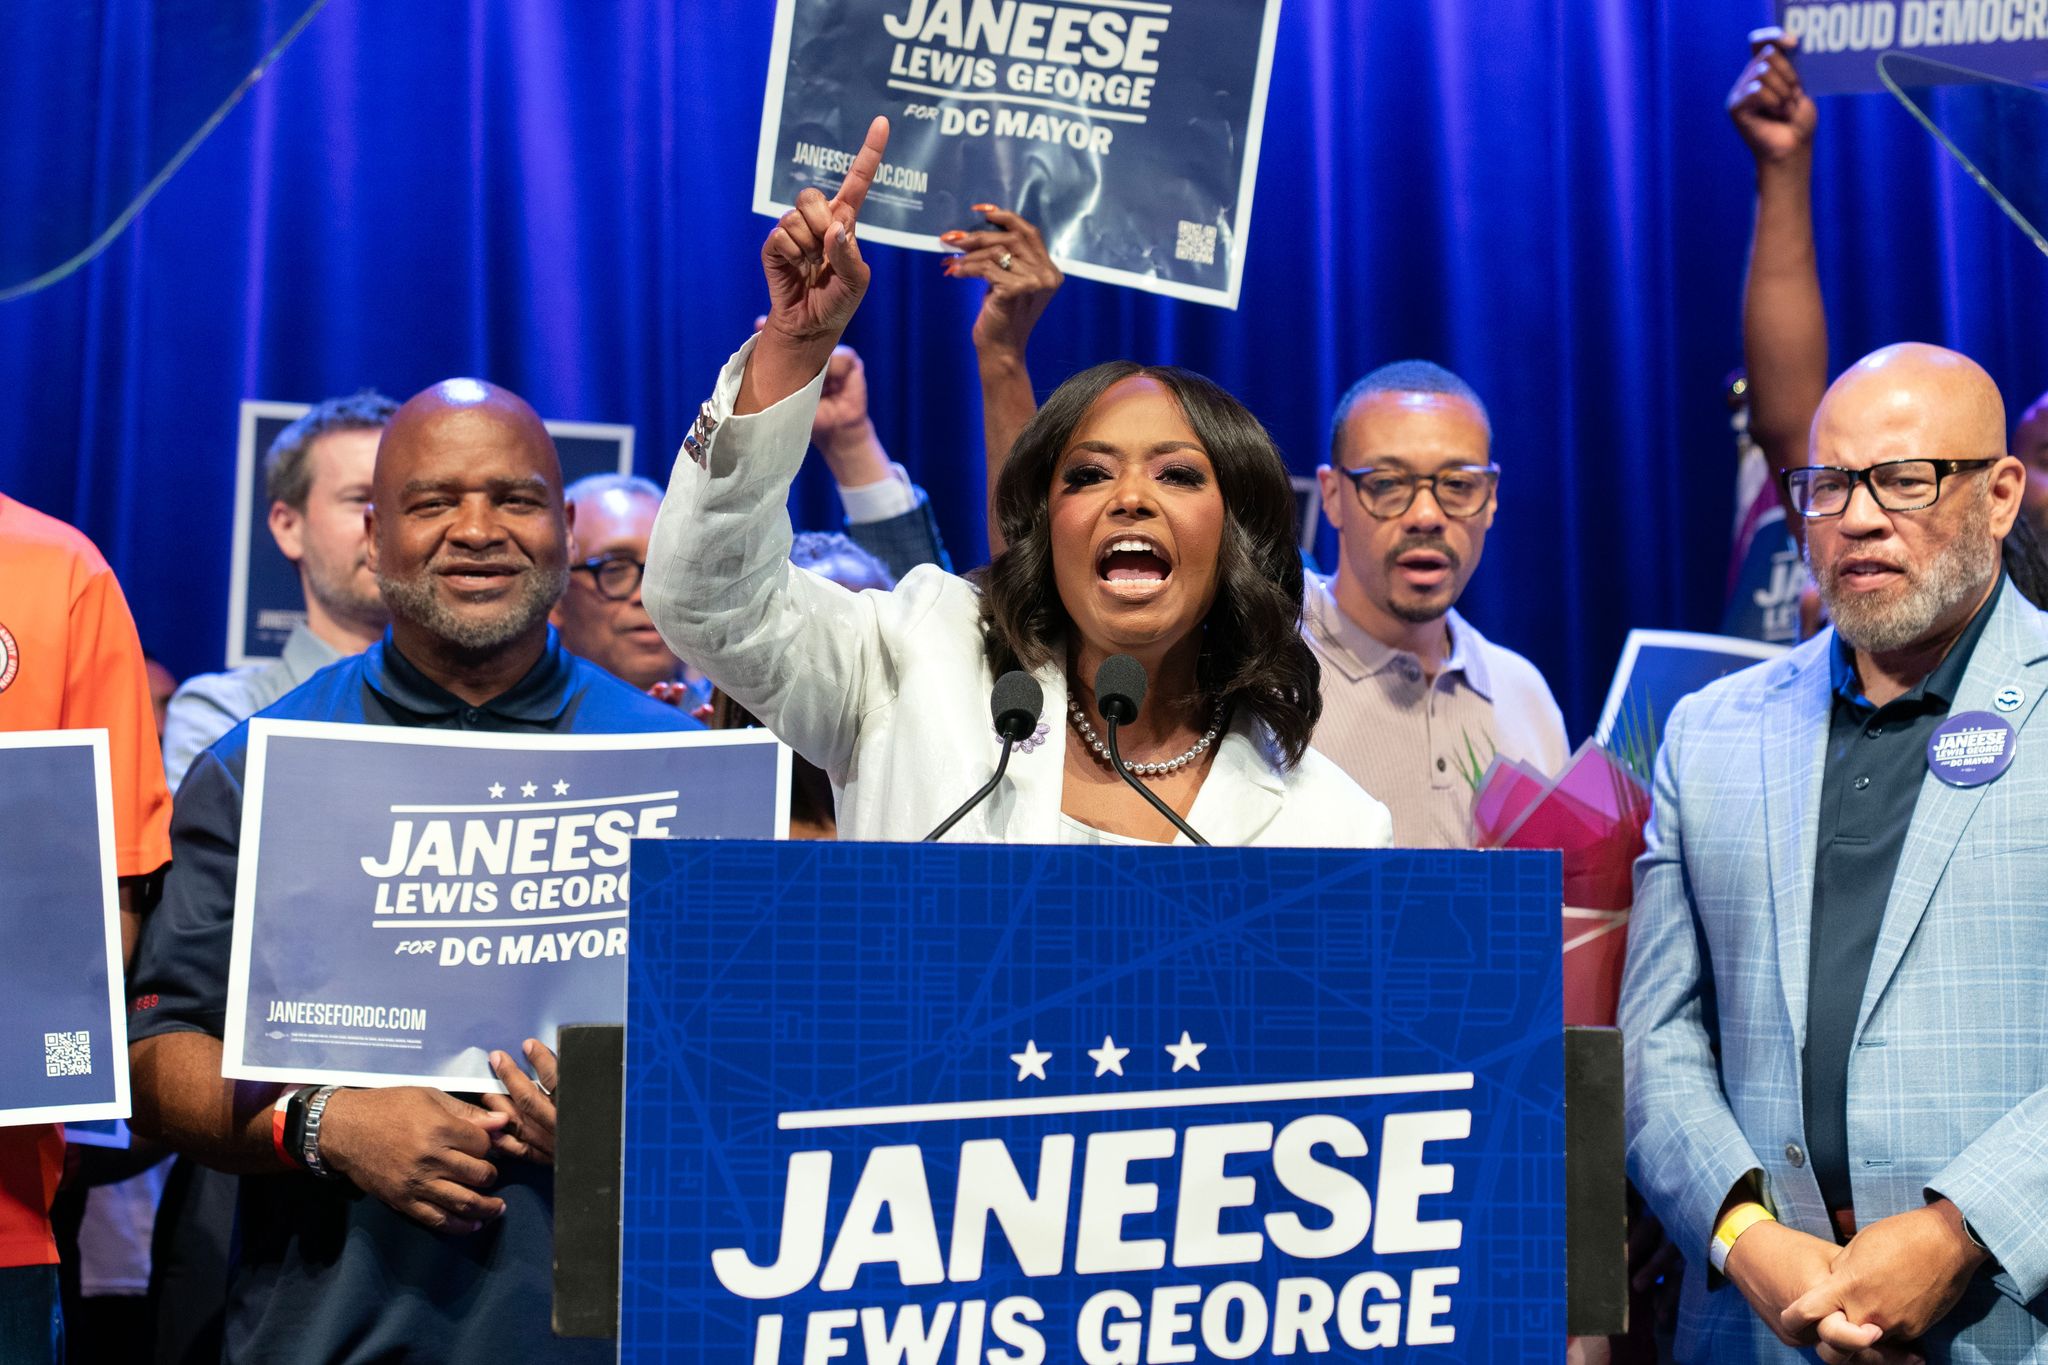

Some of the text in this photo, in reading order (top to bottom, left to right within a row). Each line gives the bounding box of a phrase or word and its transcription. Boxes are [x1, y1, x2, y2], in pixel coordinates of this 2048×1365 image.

[883, 0, 1169, 73] JANEESE
[1784, 1, 1896, 53] PROUD
[890, 43, 1156, 109] LEWIS GEORGE
[903, 103, 1114, 155] FOR DC MAYOR
[792, 141, 929, 193] JANEESEDC.COM
[1932, 732, 2007, 752] JANEESE
[1935, 748, 1965, 759] LEWIS
[1950, 758, 1963, 767] DC
[1963, 756, 1995, 766] MAYOR
[374, 881, 498, 914] LEWIS
[394, 927, 628, 966] FOR DC MAYOR
[266, 1000, 427, 1031] JANEESEFORDC.COM
[711, 1109, 1472, 1299] JANEESE
[1076, 1266, 1460, 1365] GEORGE
